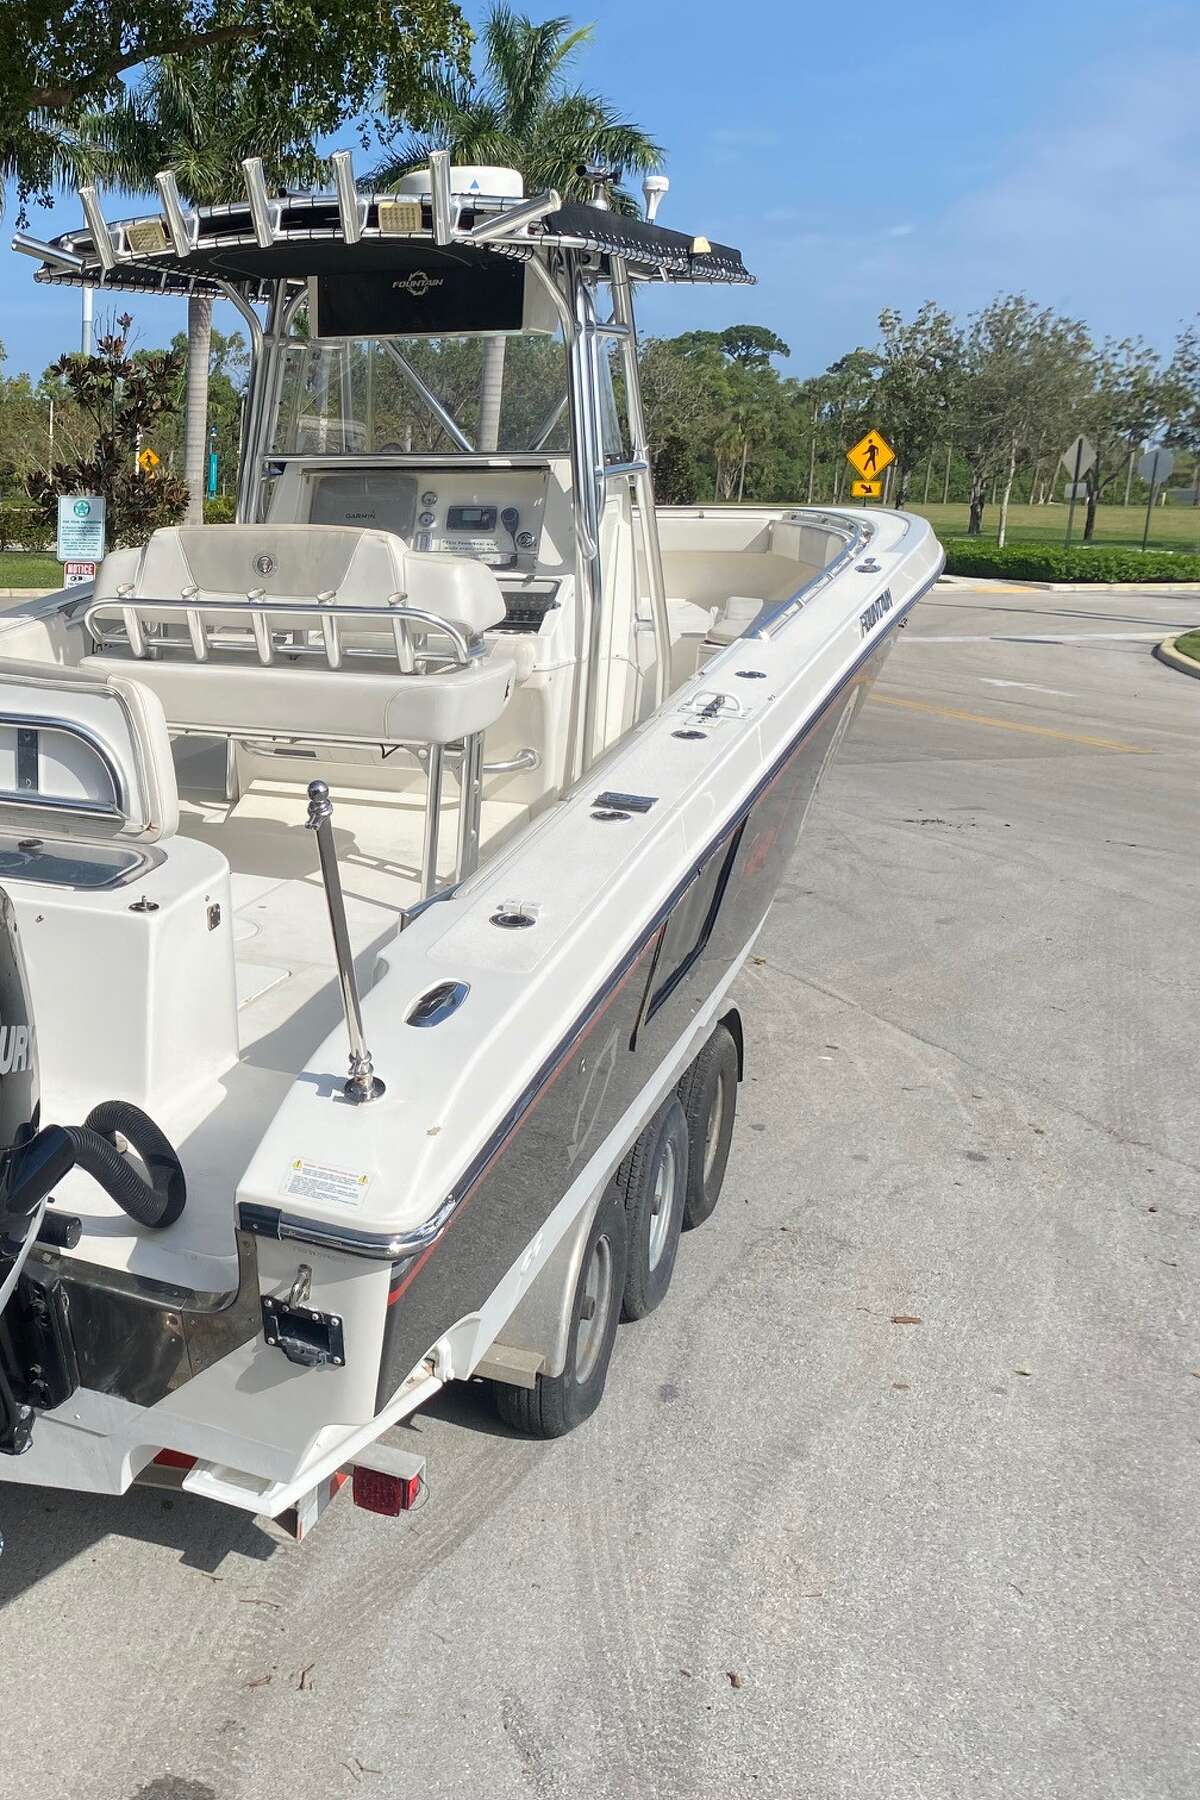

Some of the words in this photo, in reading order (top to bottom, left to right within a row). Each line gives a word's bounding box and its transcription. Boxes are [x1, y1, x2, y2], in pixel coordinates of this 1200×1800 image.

[392, 278, 444, 289] FOUNTAIN
[345, 511, 376, 519] GARMIN
[68, 563, 94, 574] NOTICE
